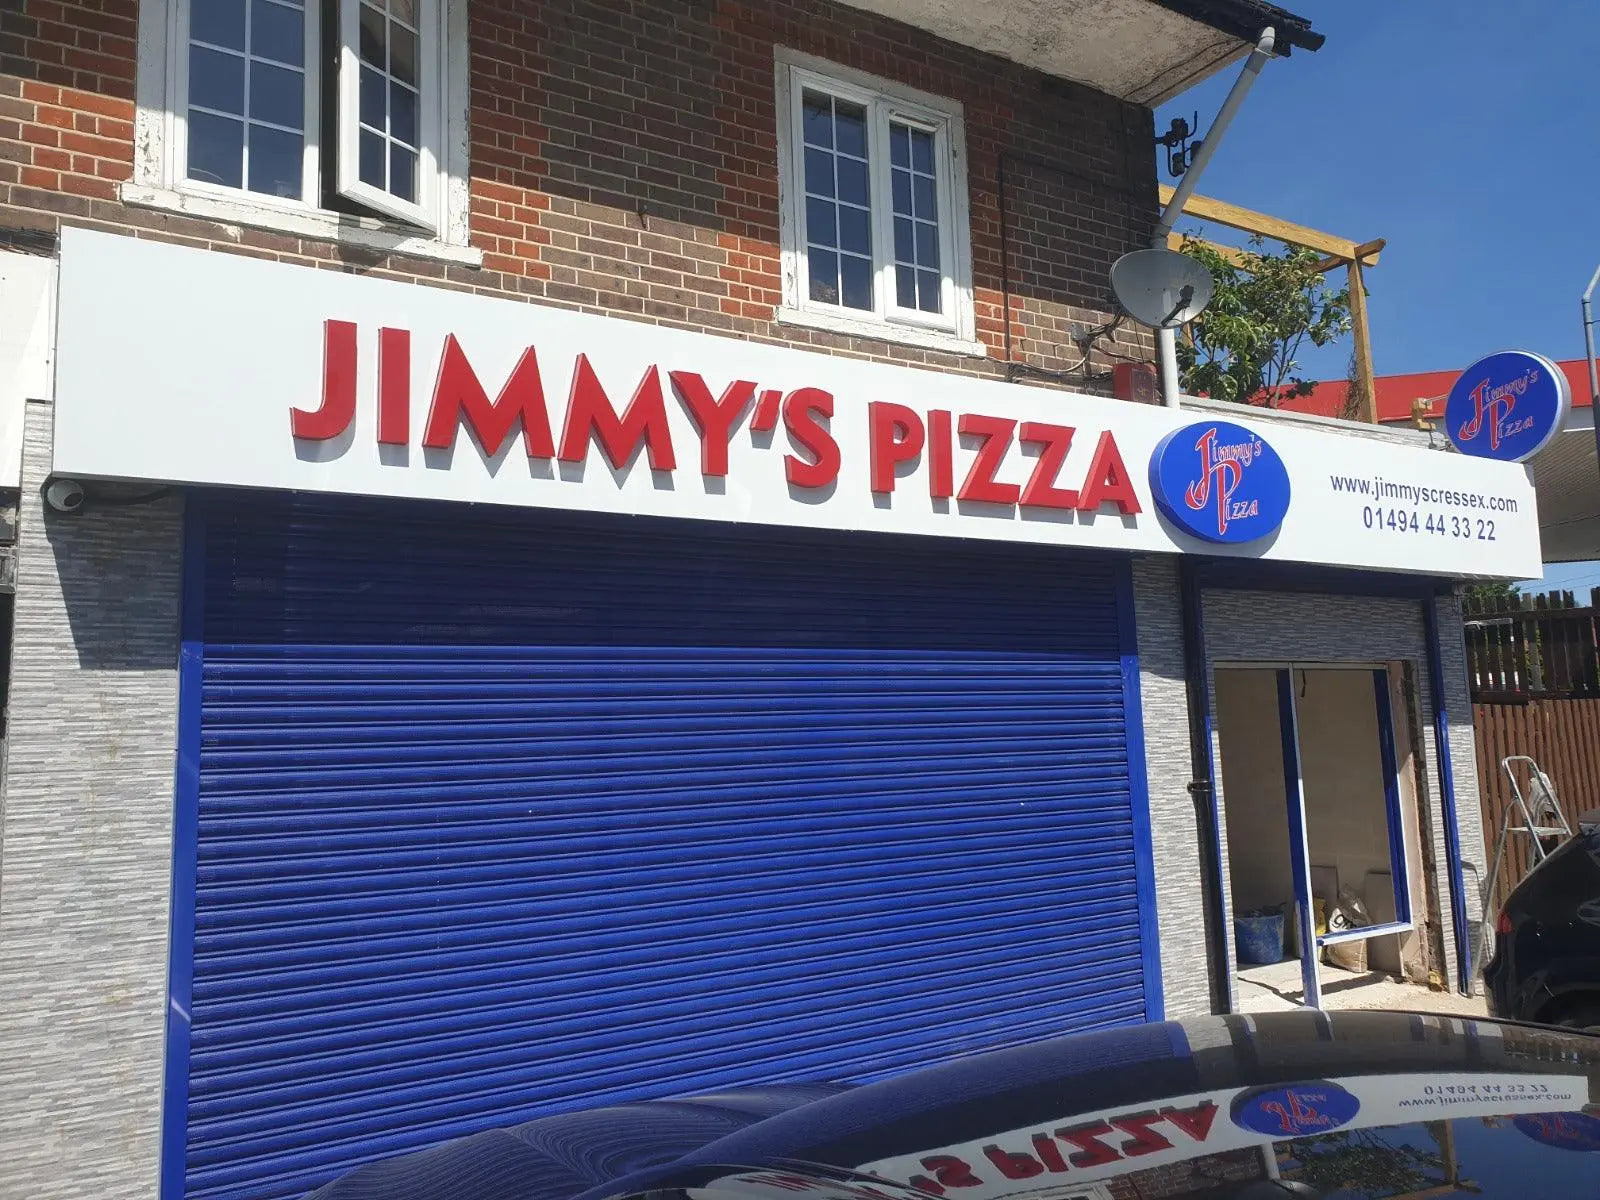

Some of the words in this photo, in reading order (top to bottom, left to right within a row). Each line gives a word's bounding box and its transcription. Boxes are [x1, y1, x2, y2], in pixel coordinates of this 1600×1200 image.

[289, 319, 842, 488] JIMMY'S
[868, 401, 1142, 515] PIZZA
[1458, 368, 1539, 441] Jimmy's
[1185, 427, 1262, 510] Jimmy's
[1330, 475, 1518, 513] www.jimmyscressex.com
[1363, 506, 1419, 533] 01494
[1425, 513, 1446, 536] 44
[1451, 516, 1471, 539] 33
[1477, 519, 1496, 541] 22
